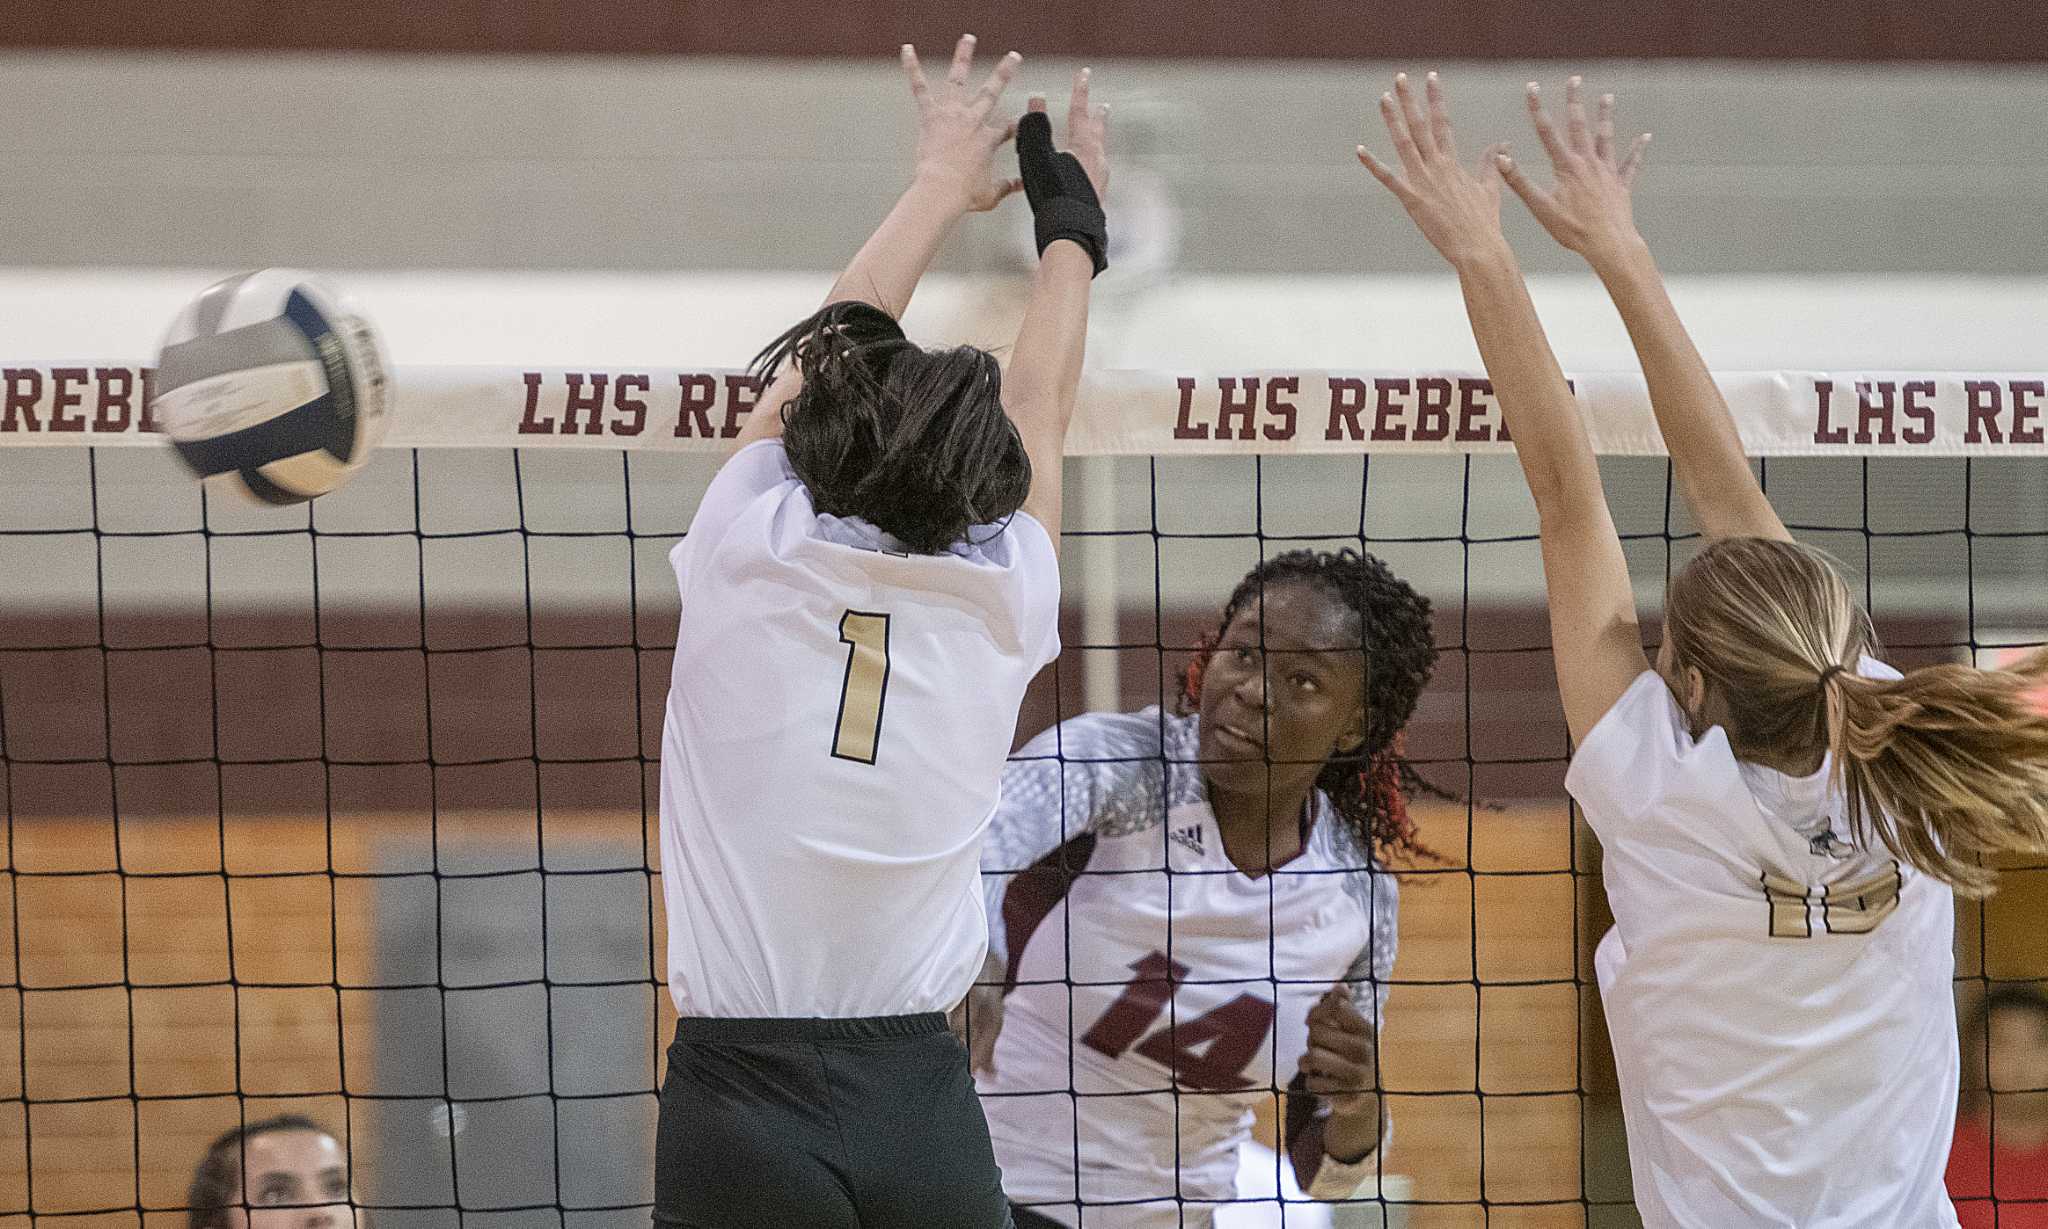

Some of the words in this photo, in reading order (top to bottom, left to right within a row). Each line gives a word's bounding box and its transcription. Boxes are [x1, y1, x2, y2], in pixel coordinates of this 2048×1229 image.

[518, 373, 649, 436] LHS
[674, 374, 777, 438] RE
[1174, 376, 1299, 440] LHS
[1325, 378, 1575, 441] REBE
[1814, 380, 1936, 444] LHS
[1964, 380, 2046, 444] RE
[831, 608, 890, 765] 1
[1079, 949, 1278, 1091] 14
